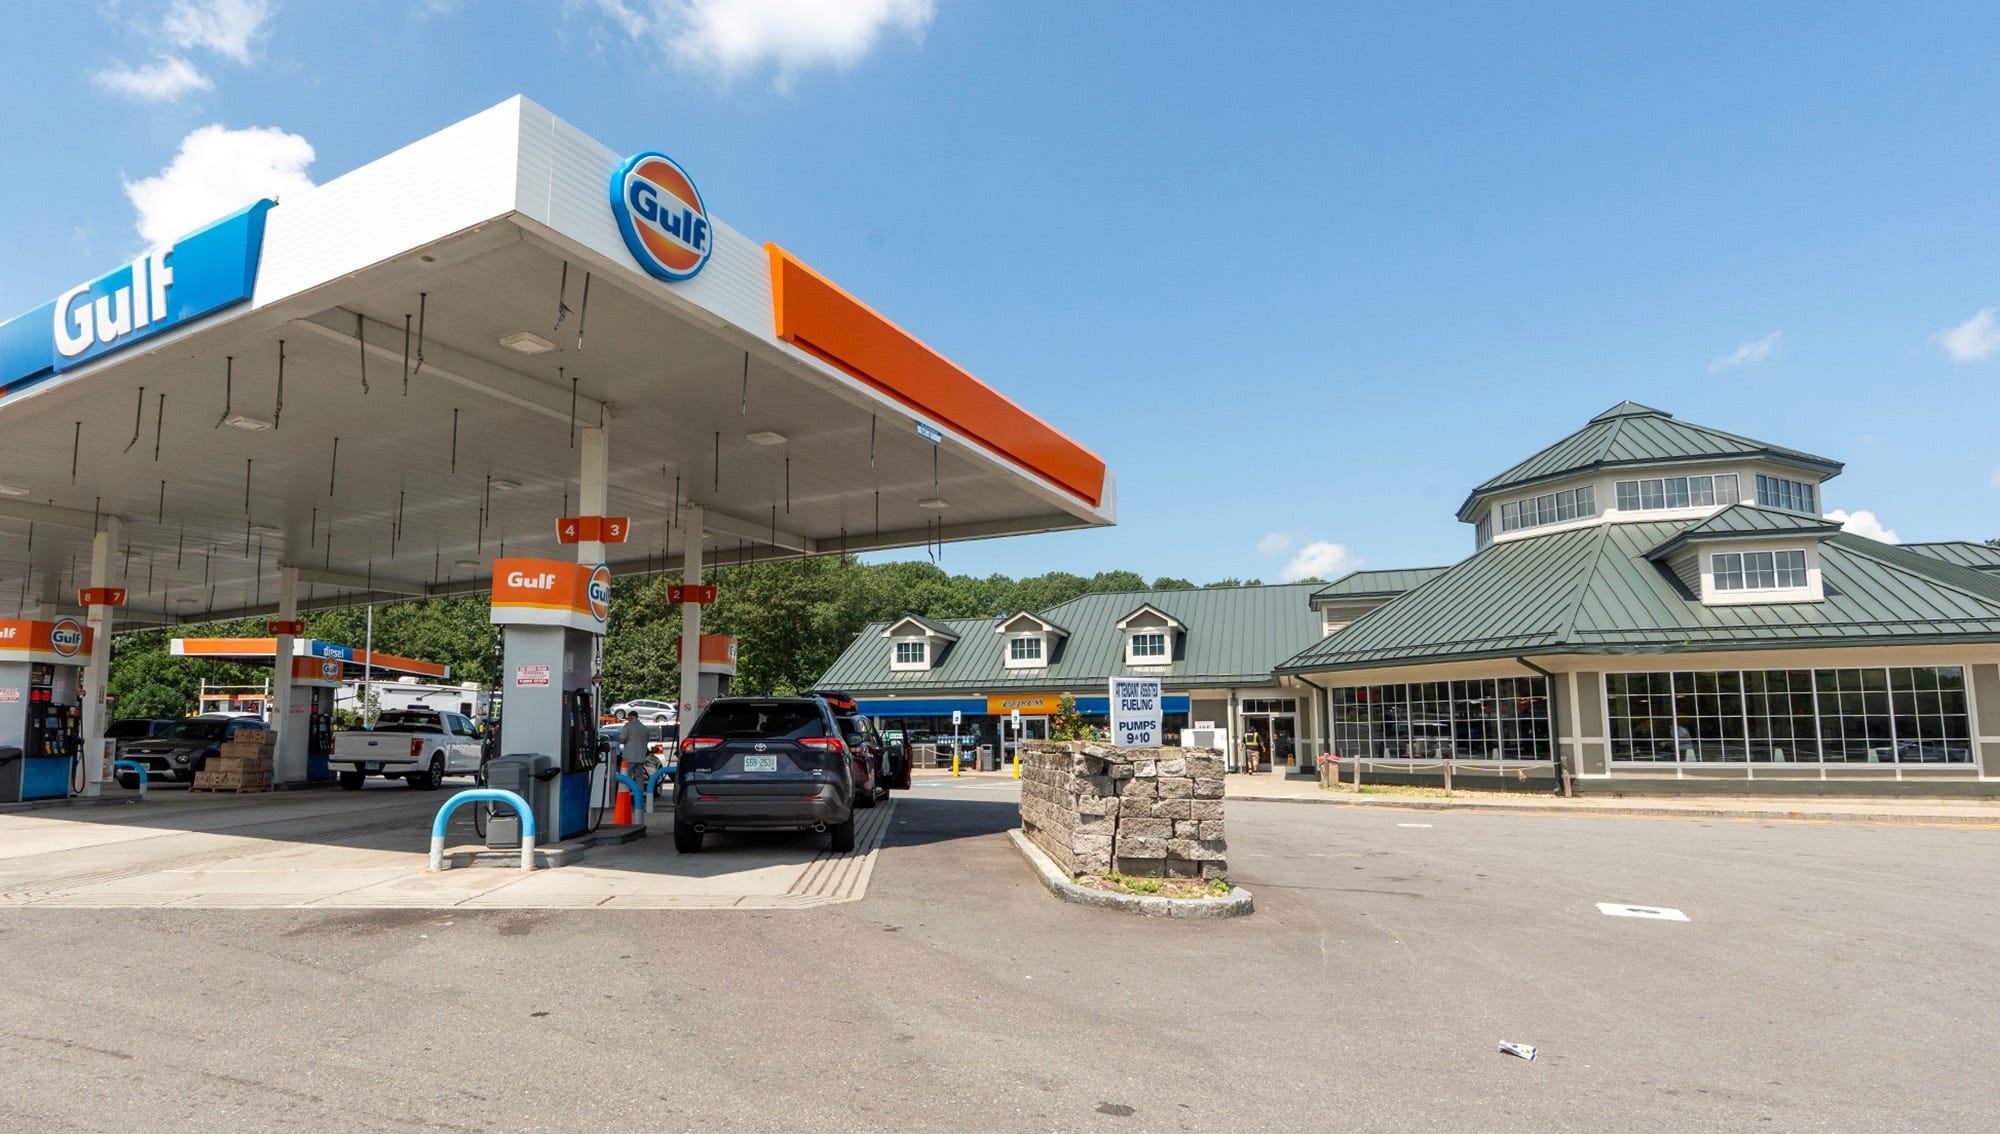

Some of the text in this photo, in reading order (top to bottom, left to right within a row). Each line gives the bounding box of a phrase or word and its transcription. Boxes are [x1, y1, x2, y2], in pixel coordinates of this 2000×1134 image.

[629, 180, 707, 251] Gulf
[53, 242, 174, 357] Gulf
[565, 524, 576, 537] 4
[610, 524, 620, 536] 3
[507, 571, 556, 590] Gulf
[113, 592, 121, 601] 7
[673, 590, 681, 599] 2
[705, 590, 711, 599] 1
[53, 631, 80, 644] Gulf
[323, 646, 344, 658] diesel
[1121, 699, 1153, 711] FUELING
[1119, 720, 1156, 731] PUMPS
